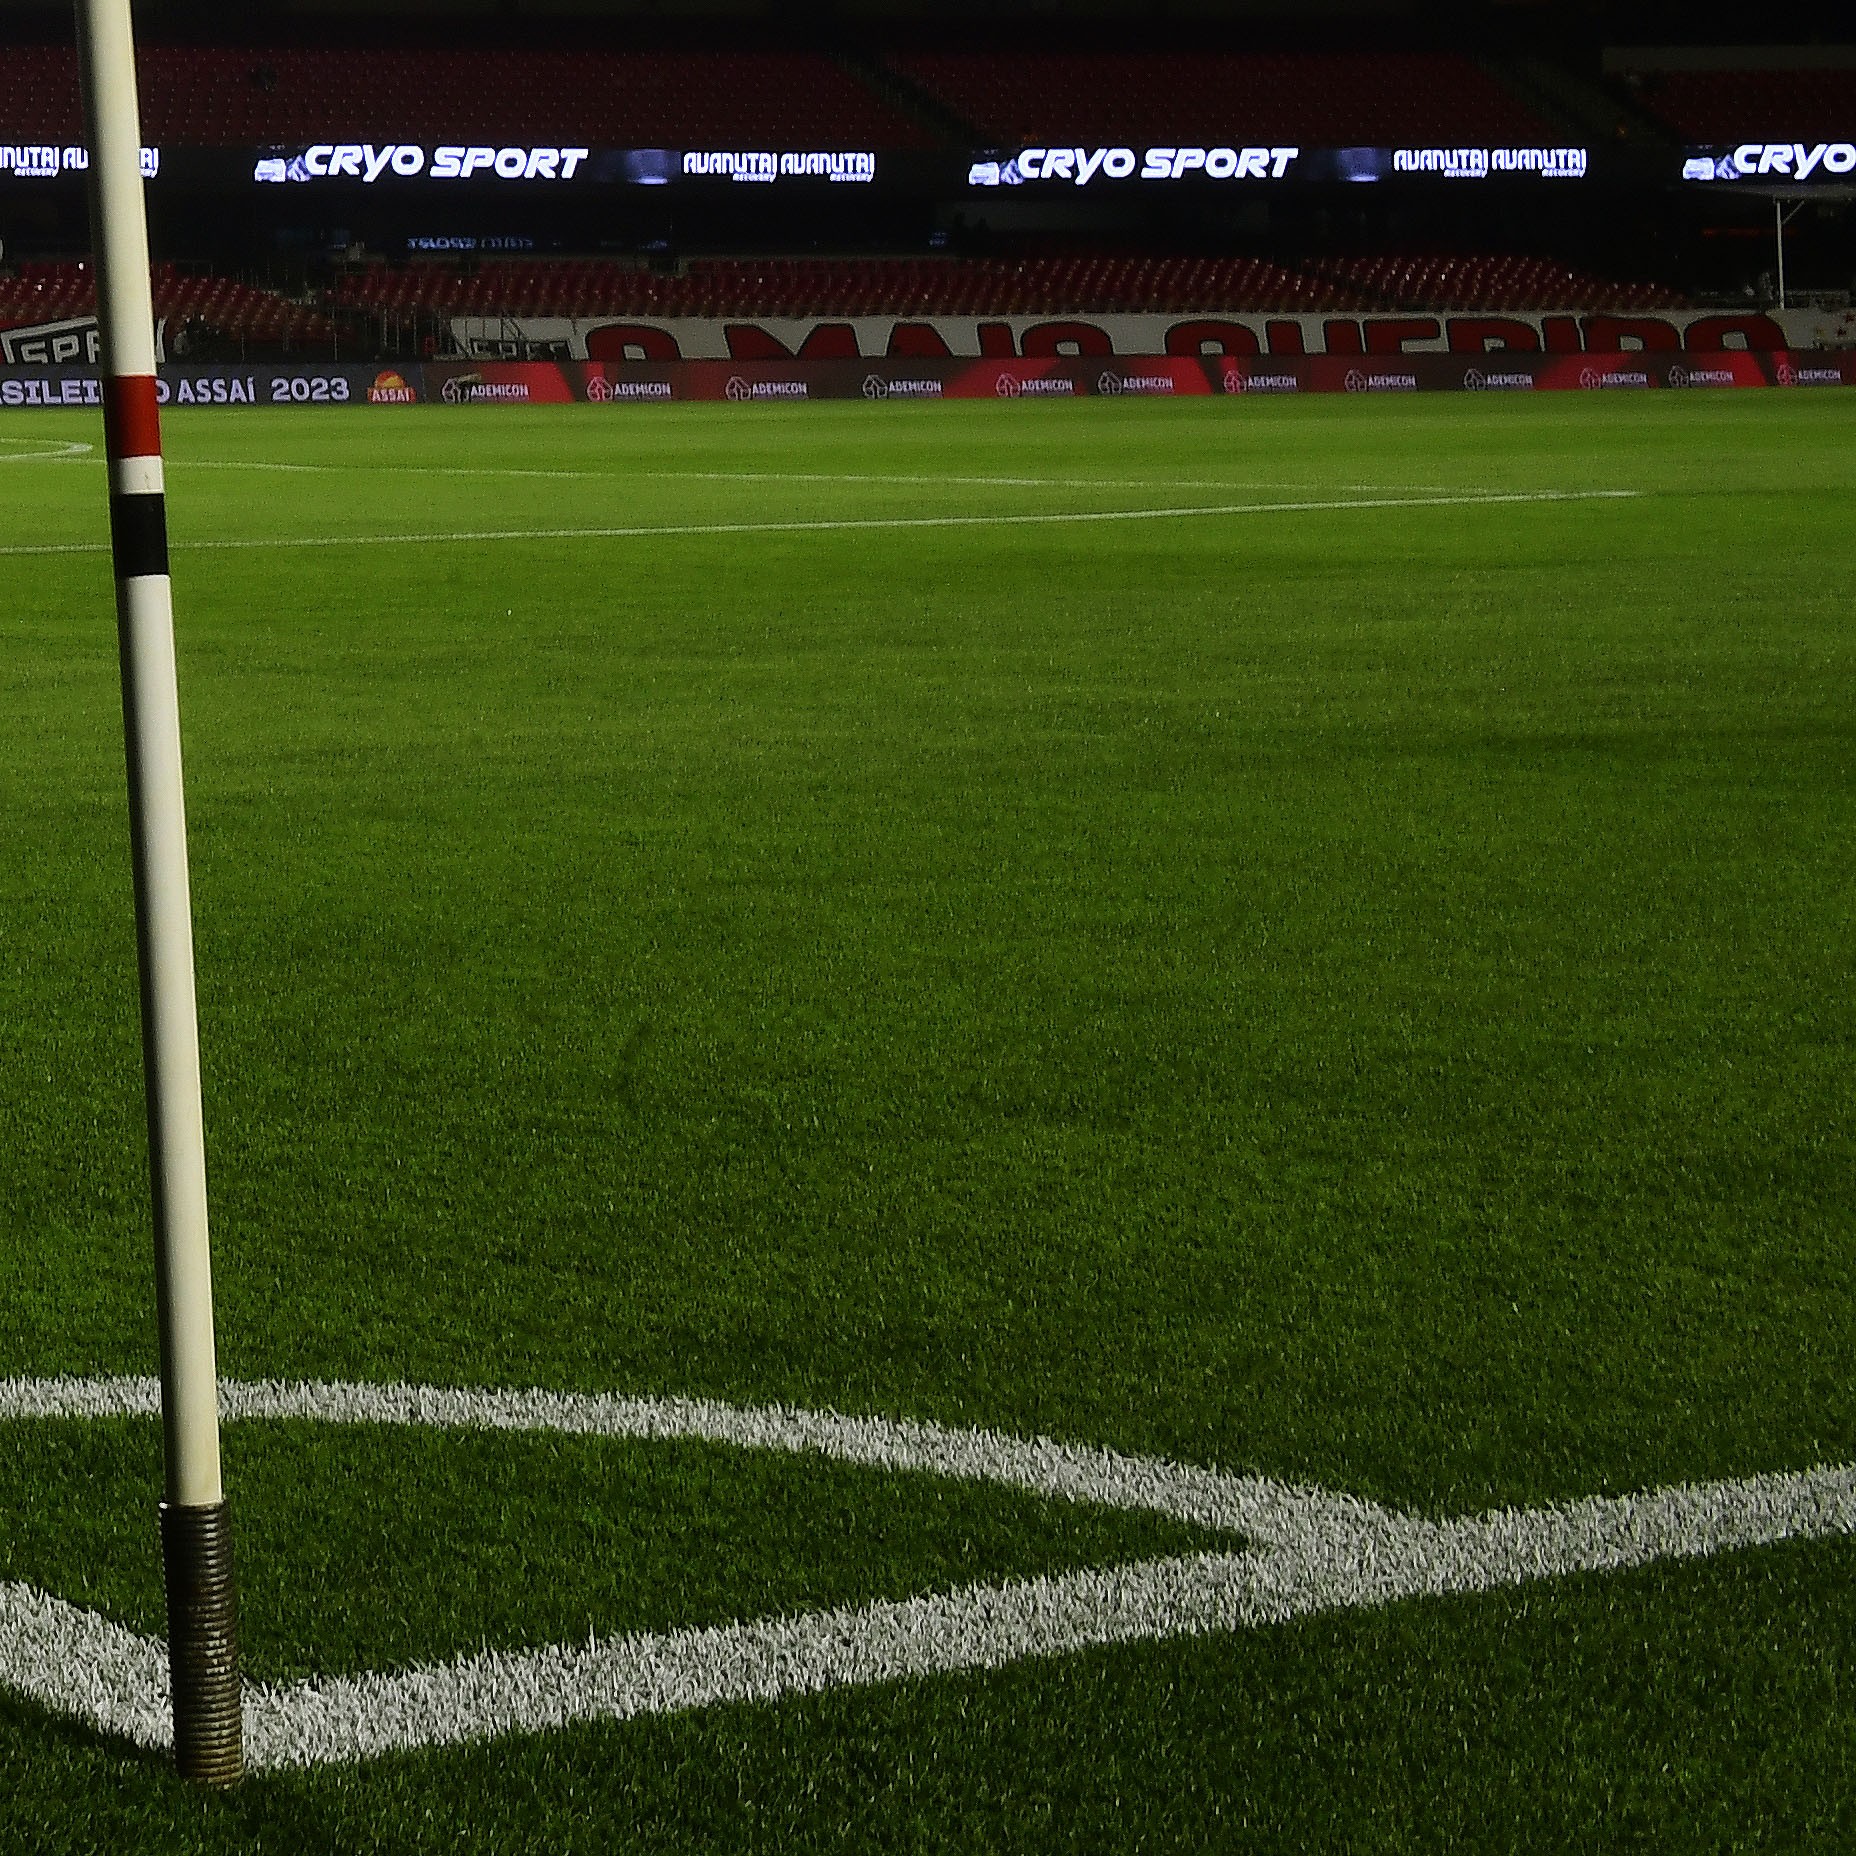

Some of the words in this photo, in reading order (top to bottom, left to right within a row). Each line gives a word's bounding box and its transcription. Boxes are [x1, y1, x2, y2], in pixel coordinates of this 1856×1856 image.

[304, 145, 424, 182] CRYO
[430, 146, 588, 179] SPORT
[1018, 148, 1136, 185] CRYO
[1141, 148, 1299, 179] SPORT
[1734, 144, 1856, 180] CRYO
[177, 376, 256, 403] ASSAÍ
[271, 377, 350, 401] 2023
[614, 384, 670, 397] ADEMICON
